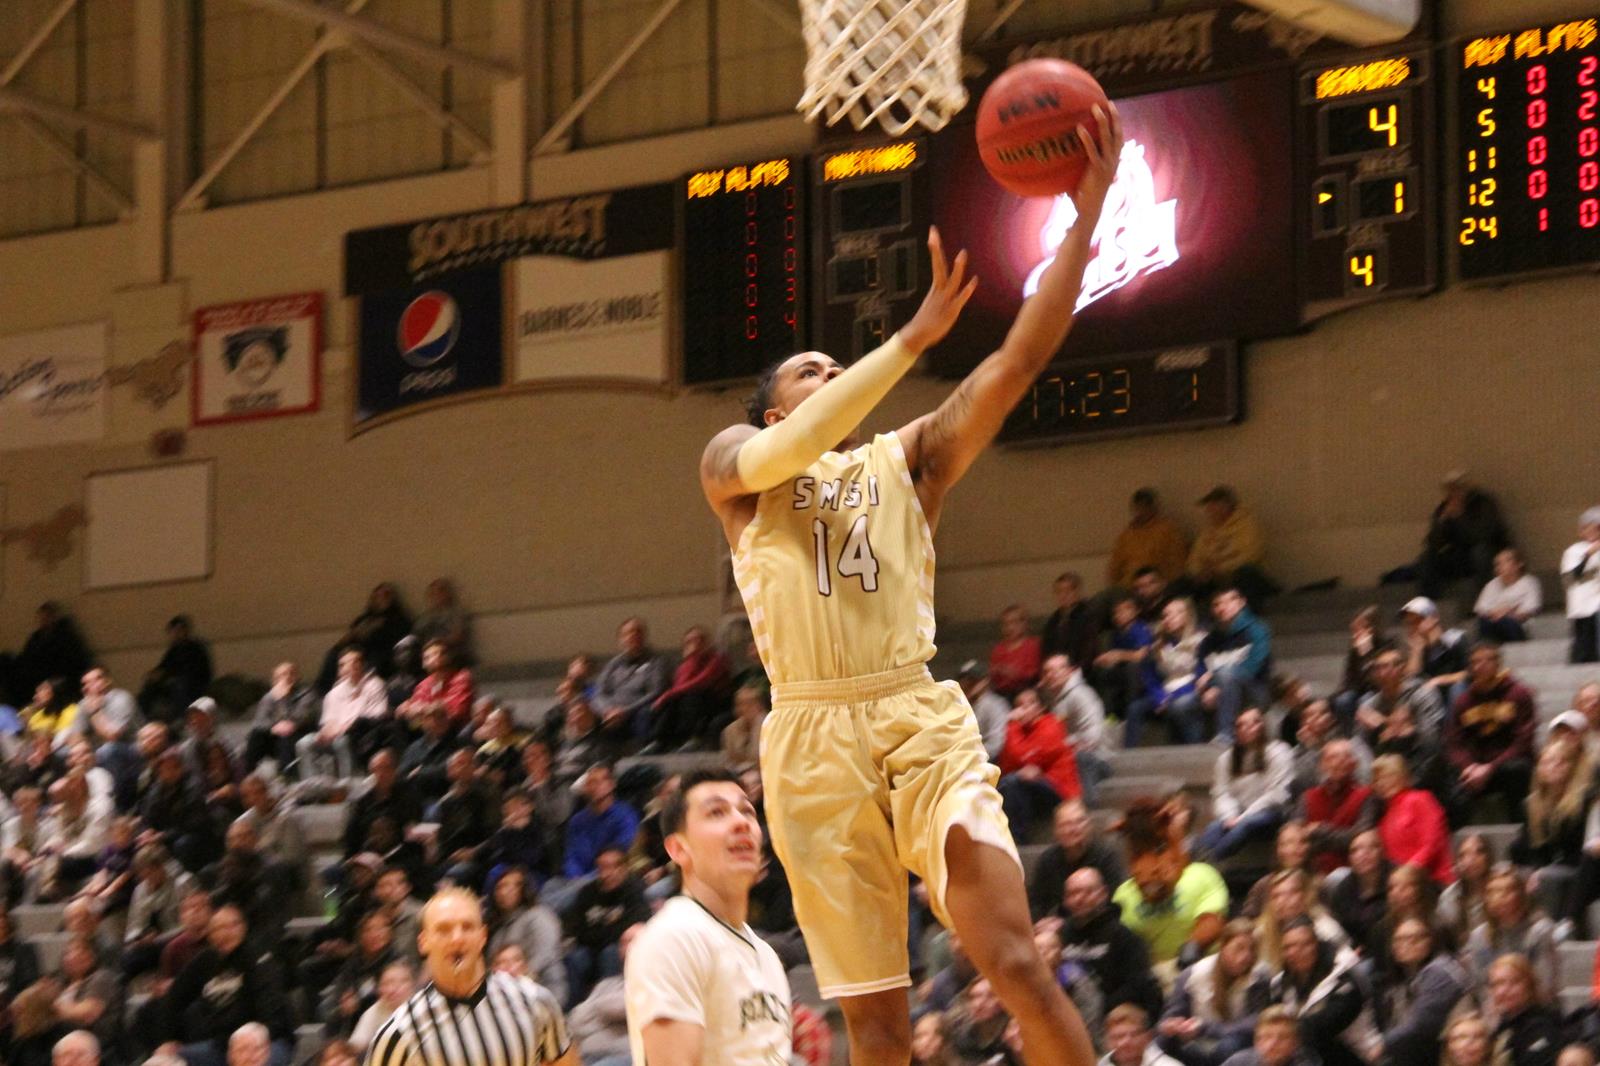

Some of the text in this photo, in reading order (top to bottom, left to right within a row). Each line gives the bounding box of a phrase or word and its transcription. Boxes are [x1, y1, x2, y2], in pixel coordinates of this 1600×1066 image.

[1476, 55, 1599, 100] 4 0 2
[1369, 104, 1398, 147] 4
[1477, 89, 1599, 137] 5 0 2
[1468, 126, 1599, 173] 11 0 0
[1394, 182, 1404, 214] 1
[1469, 160, 1599, 207] 12 0 0
[1459, 198, 1599, 246] 24 1 0
[1350, 254, 1374, 287] 4
[812, 513, 880, 597] 14
